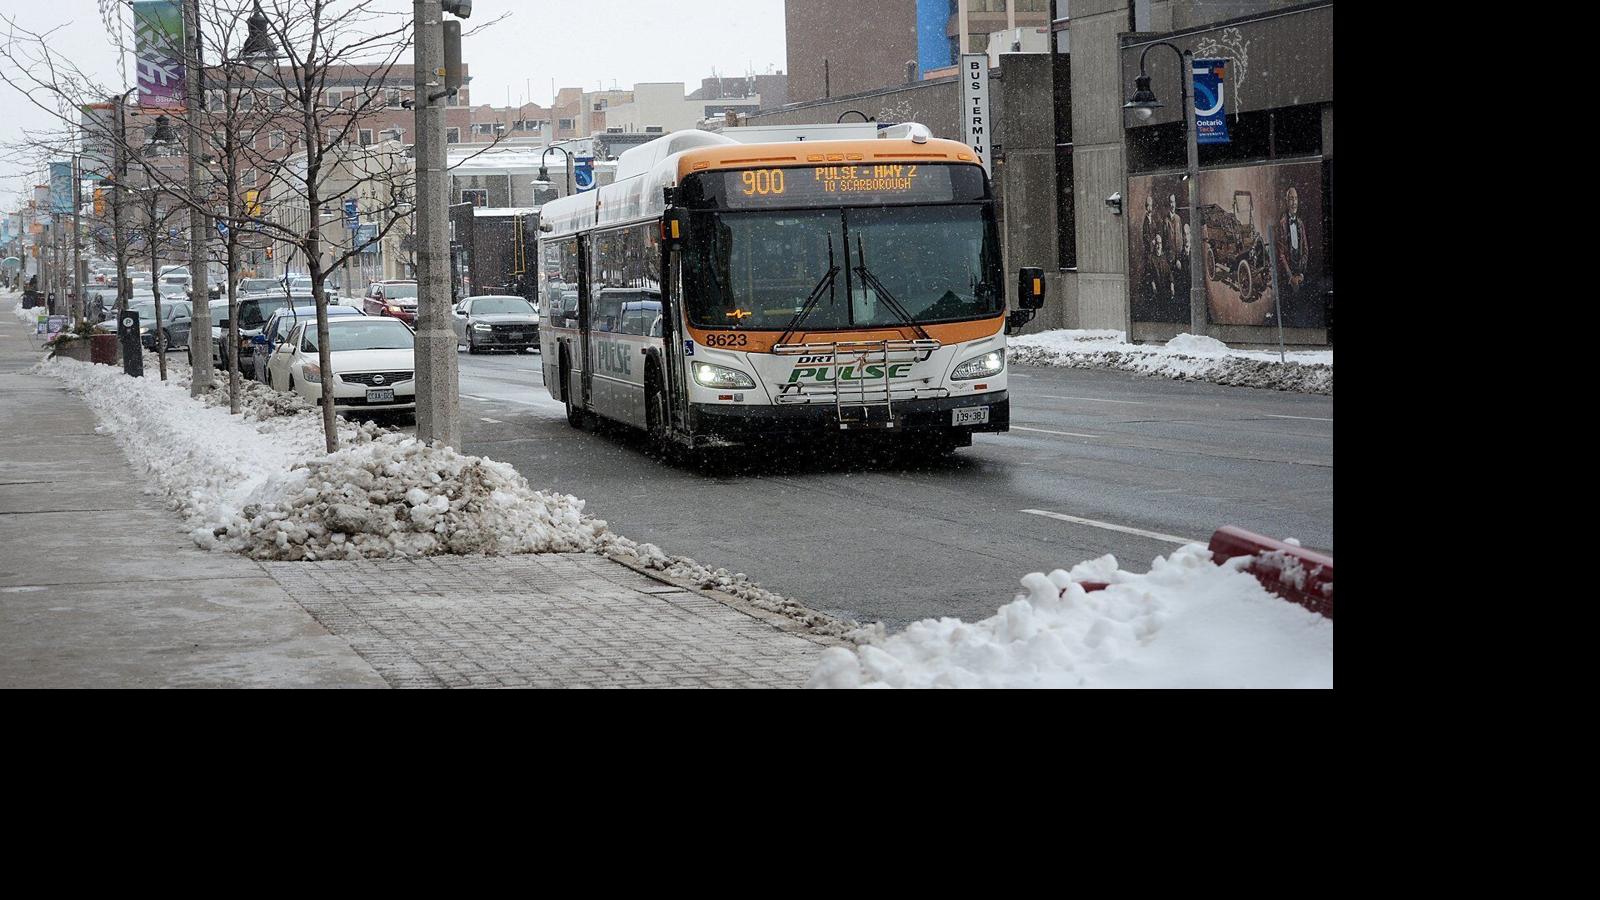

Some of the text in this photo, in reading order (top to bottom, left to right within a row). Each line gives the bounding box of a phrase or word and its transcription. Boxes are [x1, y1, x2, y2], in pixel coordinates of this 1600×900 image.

[970, 62, 980, 90] BUS
[815, 166, 859, 181] PULSE
[874, 165, 902, 179] HWY
[907, 164, 917, 177] 2
[742, 169, 785, 195] 900
[823, 178, 912, 192] TO SCARBOROUGH
[706, 334, 748, 347] 8623
[598, 340, 631, 376] PULSE
[797, 355, 834, 364] DRT
[787, 363, 912, 383] PULSE
